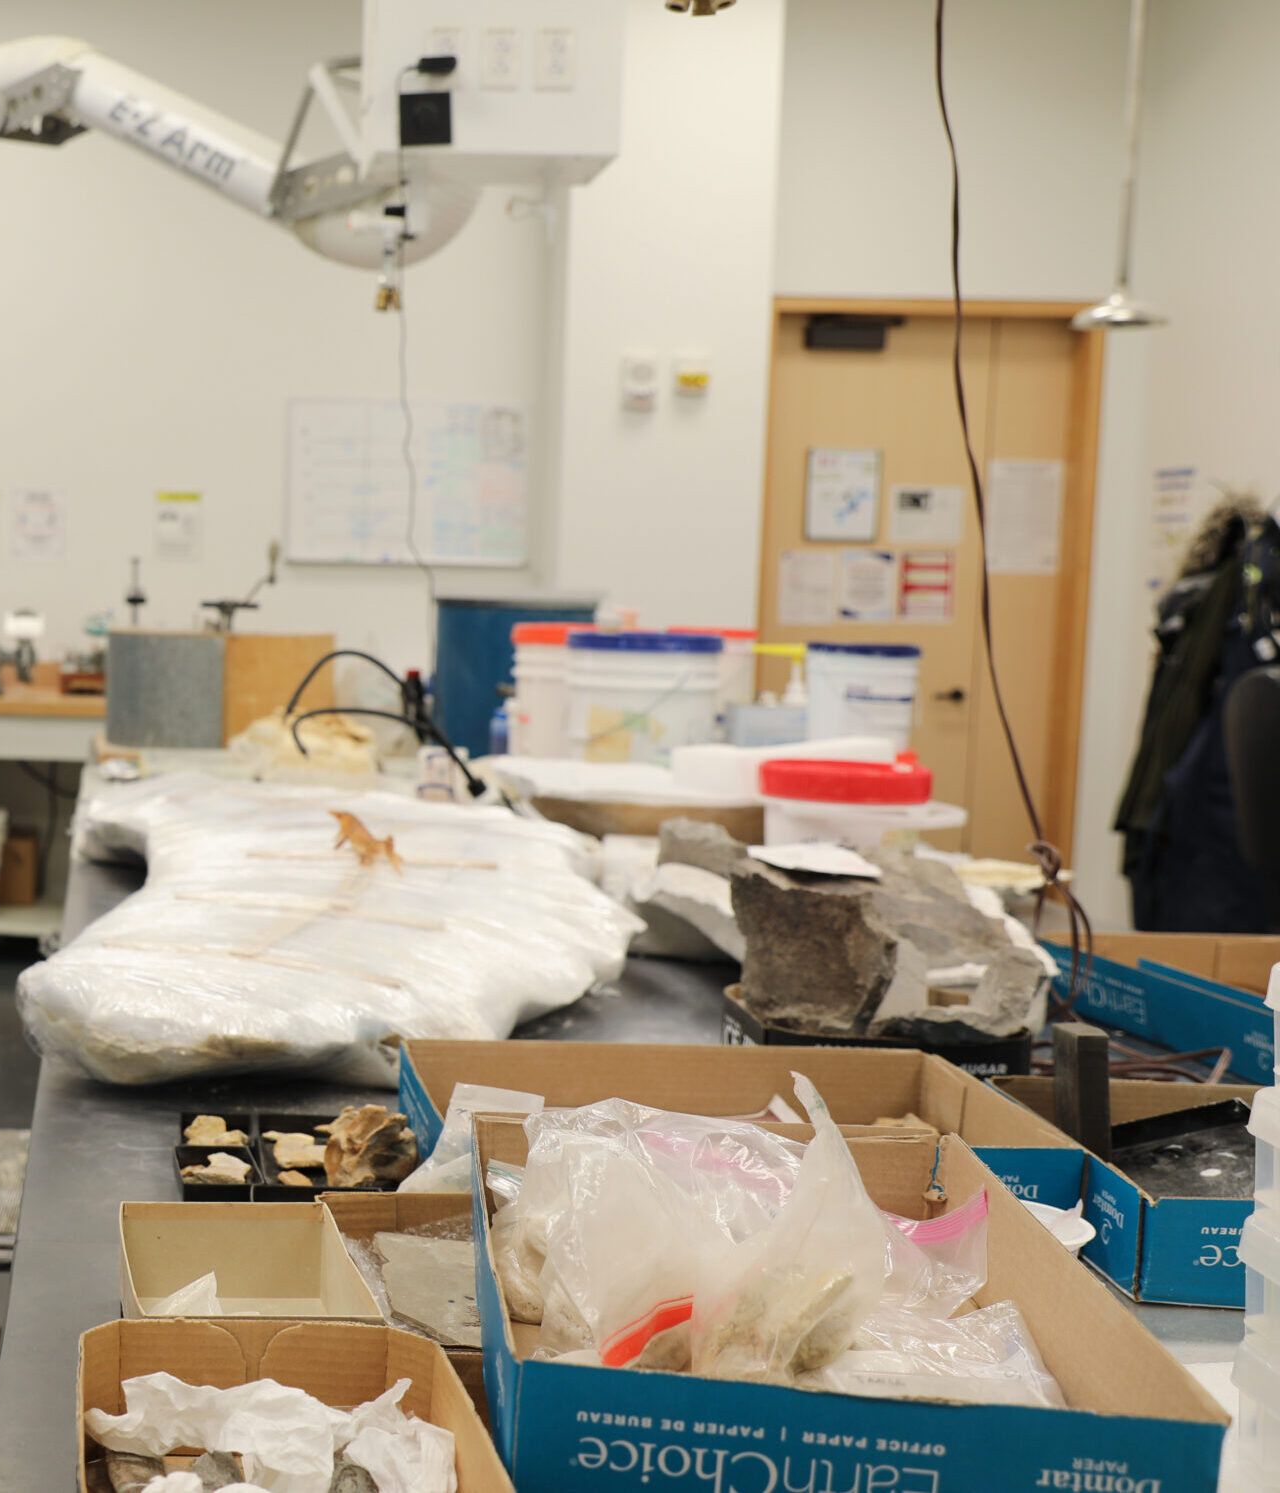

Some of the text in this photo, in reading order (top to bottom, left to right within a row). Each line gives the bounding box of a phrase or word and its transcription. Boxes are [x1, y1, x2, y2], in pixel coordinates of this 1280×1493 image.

[160, 126, 236, 181] Arm
[1093, 1192, 1125, 1229] Domtar
[576, 1411, 946, 1457] OFFICE PAPER PAPIER DE BUREAU
[1072, 1456, 1129, 1475] PAPER
